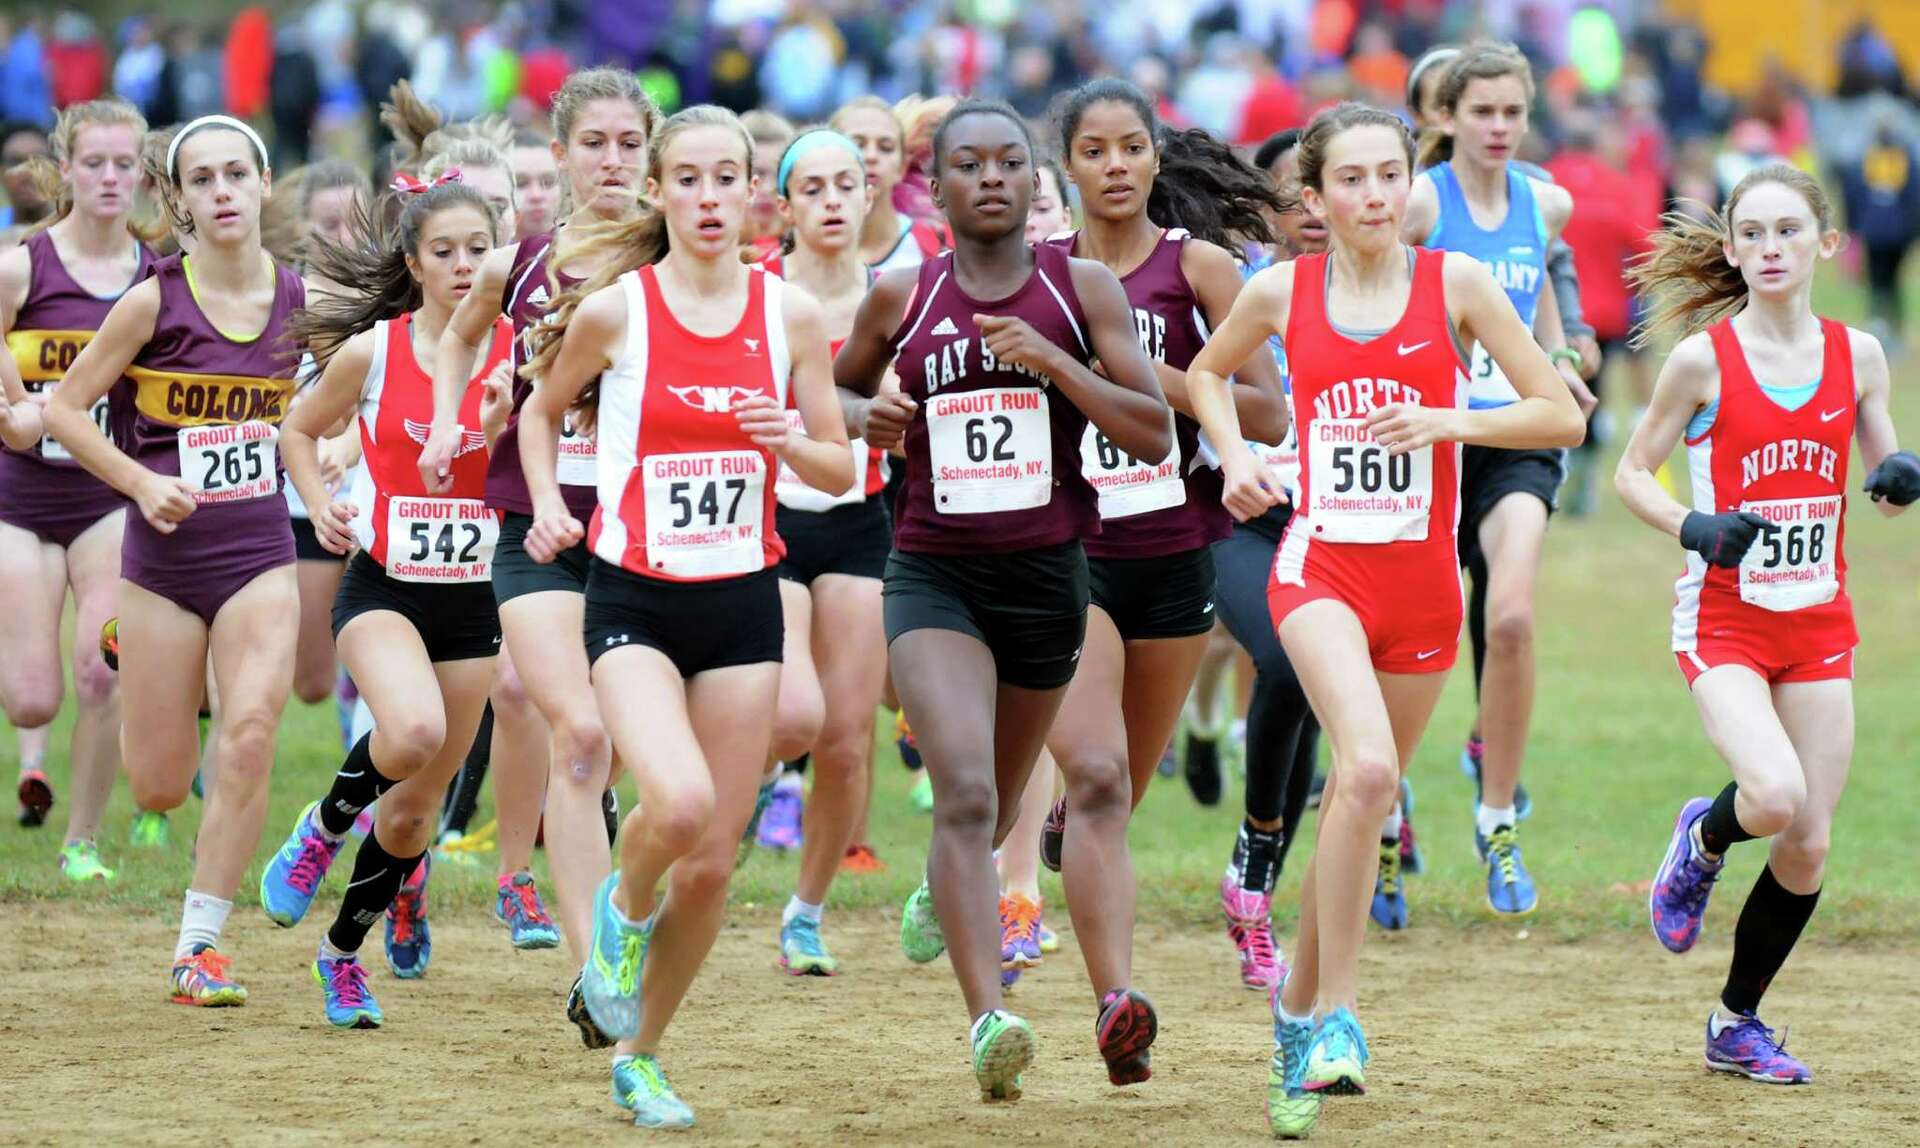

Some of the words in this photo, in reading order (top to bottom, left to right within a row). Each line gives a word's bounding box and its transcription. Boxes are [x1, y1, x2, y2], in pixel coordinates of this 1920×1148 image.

[1487, 260, 1540, 294] ANY
[1131, 308, 1166, 364] RE
[39, 337, 88, 372] CO
[924, 337, 970, 394] BAY
[936, 395, 994, 416] GROUT
[1001, 393, 1040, 411] RUN
[1313, 377, 1422, 420] NORTH
[187, 427, 238, 449] GROUT
[242, 424, 271, 440] RUN
[965, 415, 1016, 462] 62
[1096, 432, 1137, 470] 6
[201, 441, 262, 489] 265
[655, 459, 713, 478] GROUT
[720, 457, 757, 475] RUN
[940, 463, 1023, 481] Schenectady,
[1026, 461, 1042, 475] NY
[1088, 468, 1155, 488] henectady,
[1157, 463, 1173, 477] NY
[1332, 447, 1411, 493] 560
[1741, 438, 1838, 489] NORTH
[260, 479, 272, 493] NY
[399, 501, 453, 519] GROUT
[459, 503, 492, 520] RUN
[670, 479, 746, 528] 547
[1319, 496, 1402, 512] Schenectady,
[1406, 496, 1423, 509] NY
[1807, 501, 1836, 519] RUN
[409, 522, 482, 563] 542
[738, 525, 753, 539] NY
[1762, 523, 1825, 568] 568
[395, 563, 468, 579] Schenectady,
[471, 564, 486, 576] NY
